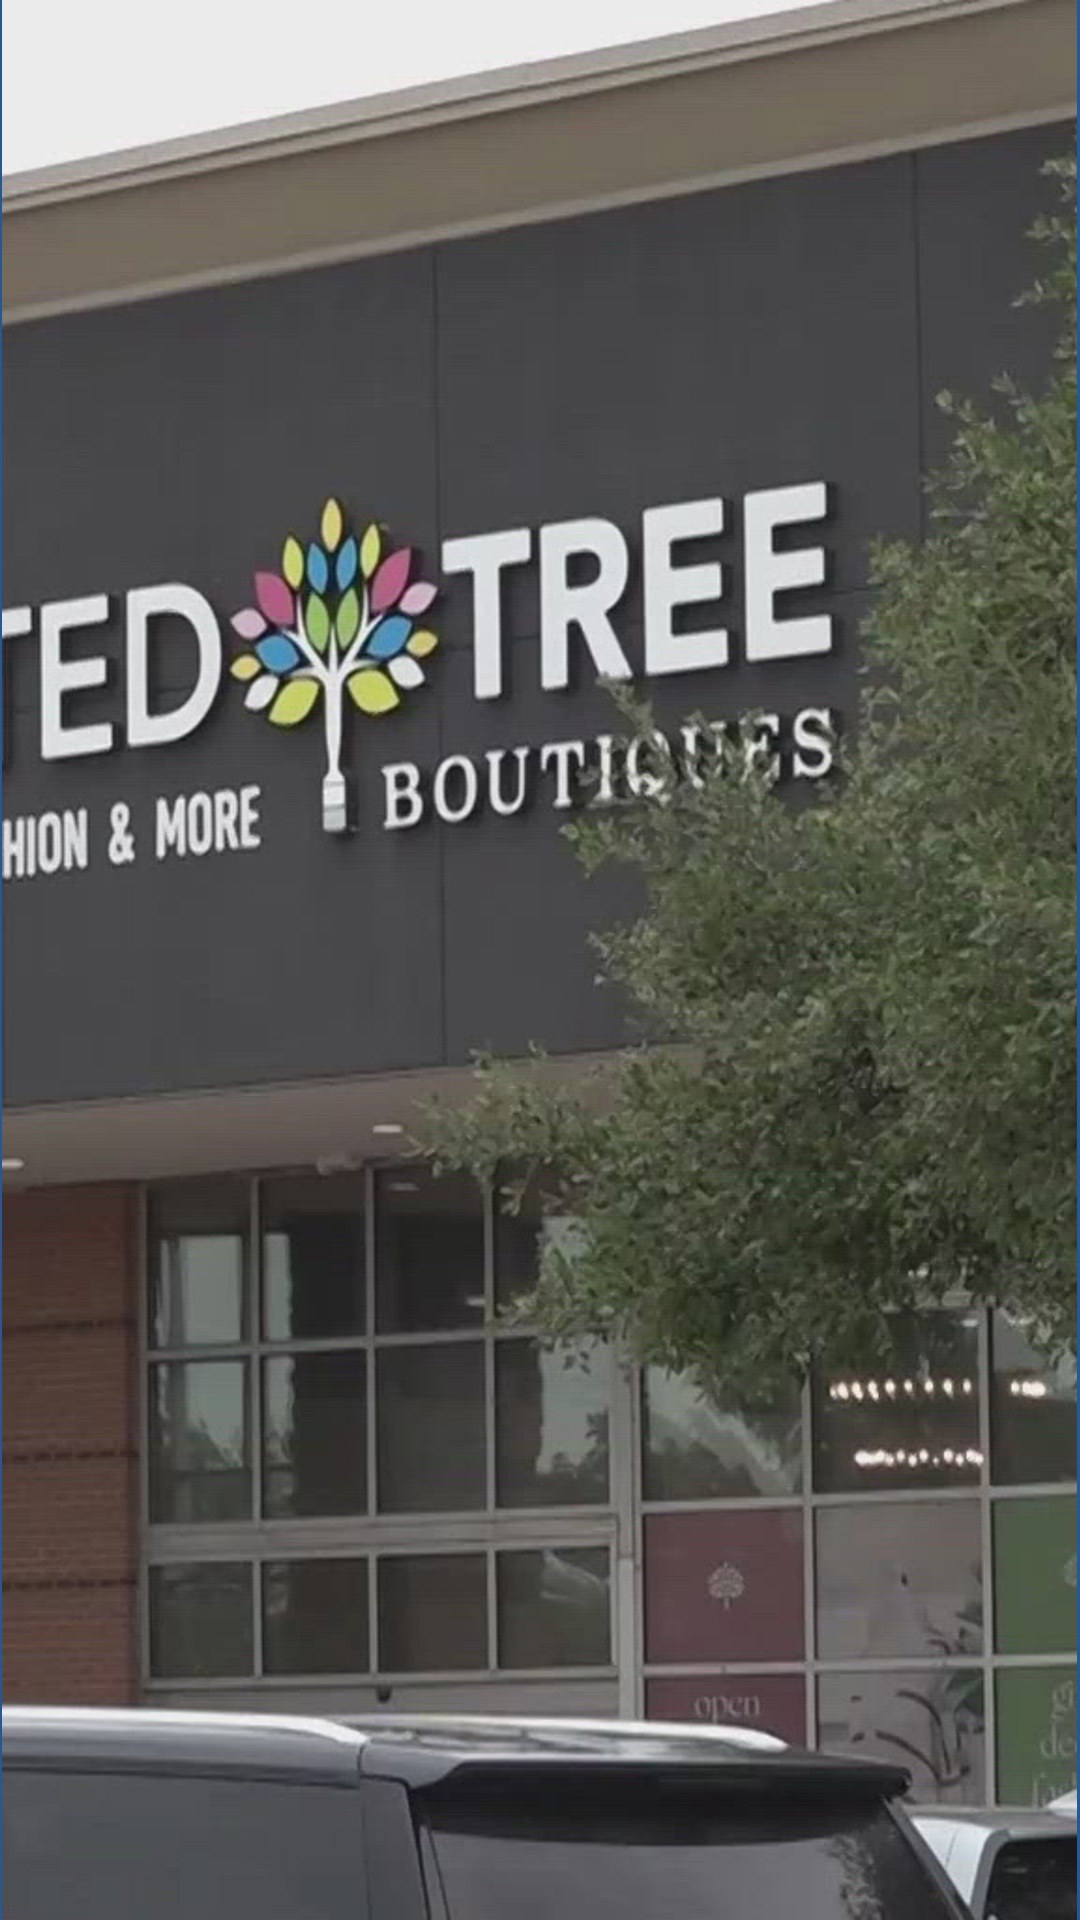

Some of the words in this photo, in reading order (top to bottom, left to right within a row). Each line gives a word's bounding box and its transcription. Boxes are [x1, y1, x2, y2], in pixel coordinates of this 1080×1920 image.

[441, 483, 833, 699] TREE
[2, 807, 88, 878] HION
[108, 802, 135, 864] &
[155, 785, 261, 859] MORE
[694, 1695, 761, 1725] open
[1040, 1721, 1077, 1758] de
